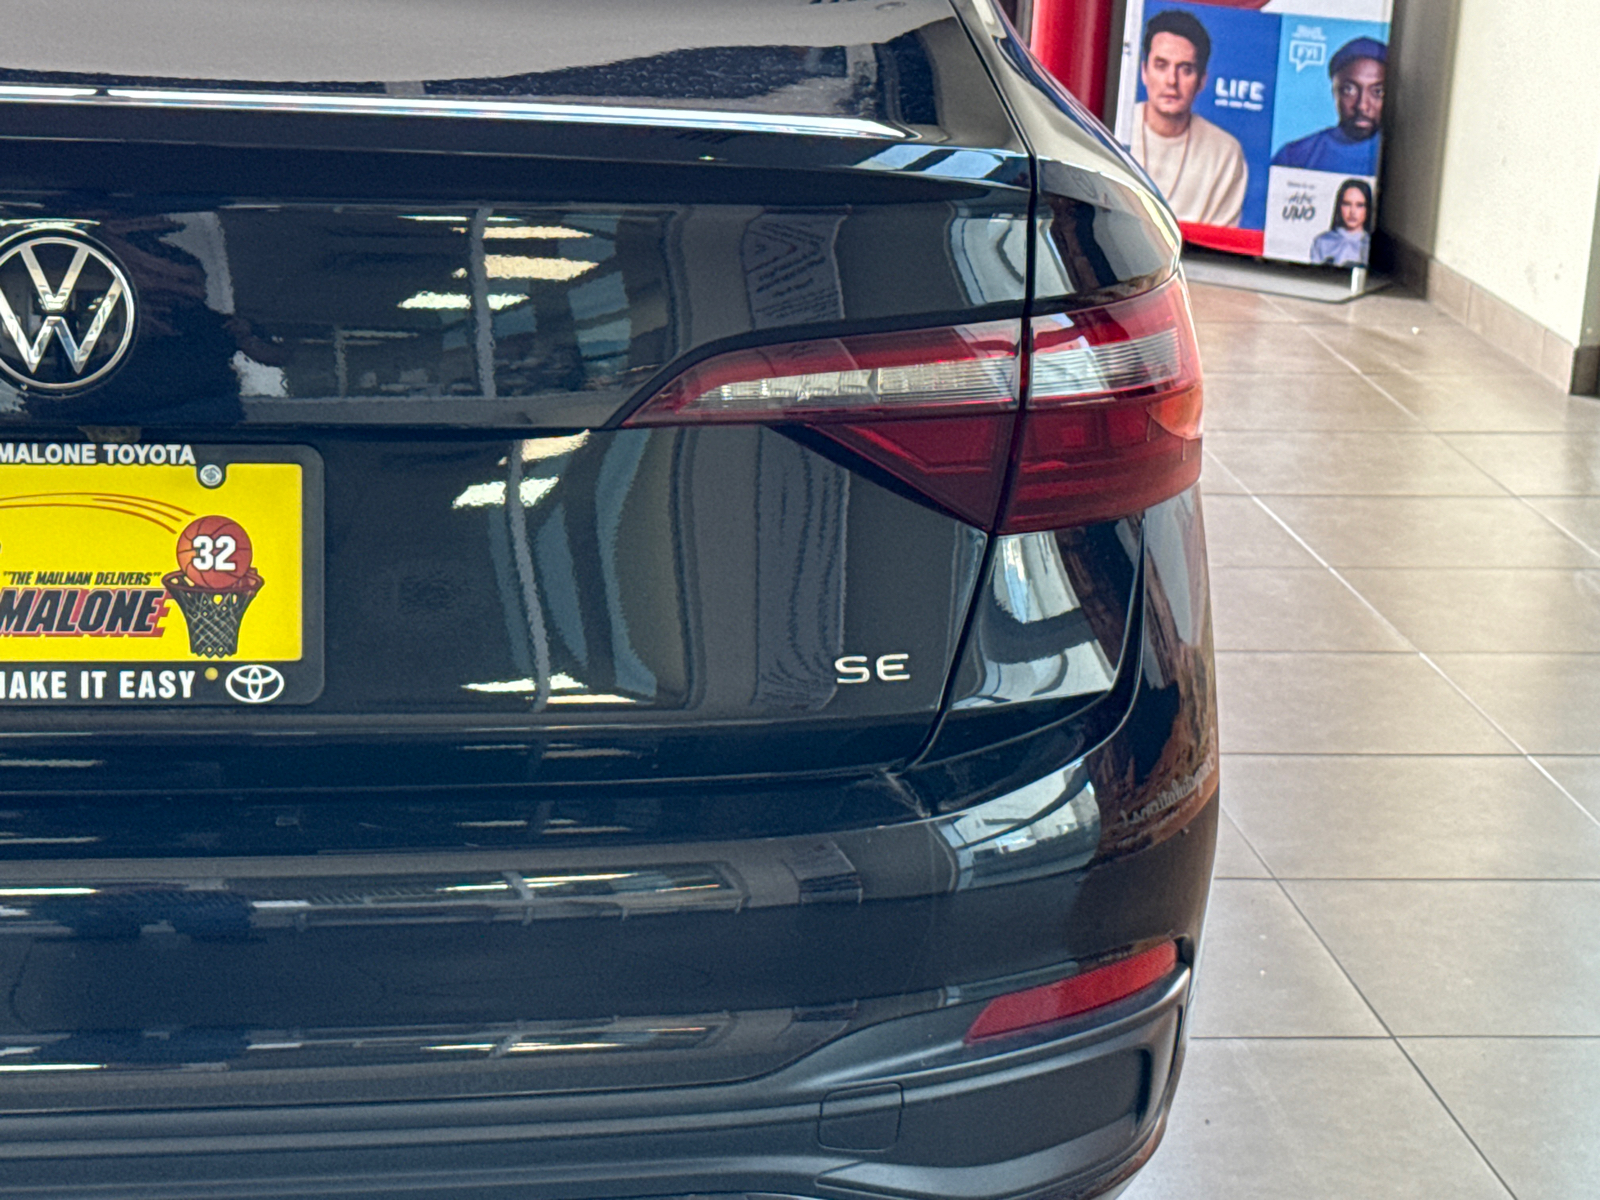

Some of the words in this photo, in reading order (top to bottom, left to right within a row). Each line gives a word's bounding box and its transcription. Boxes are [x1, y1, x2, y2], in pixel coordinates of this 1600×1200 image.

[1215, 77, 1265, 102] LIFE
[0, 442, 97, 464] MALONE
[102, 443, 196, 464] TOYOTA
[192, 535, 236, 571] 32
[35, 571, 93, 586] MAILMAN
[0, 587, 168, 637] MALONE
[834, 653, 911, 684] SE
[0, 671, 67, 699] AKE
[80, 671, 107, 699] IT
[119, 671, 196, 699] EASY
